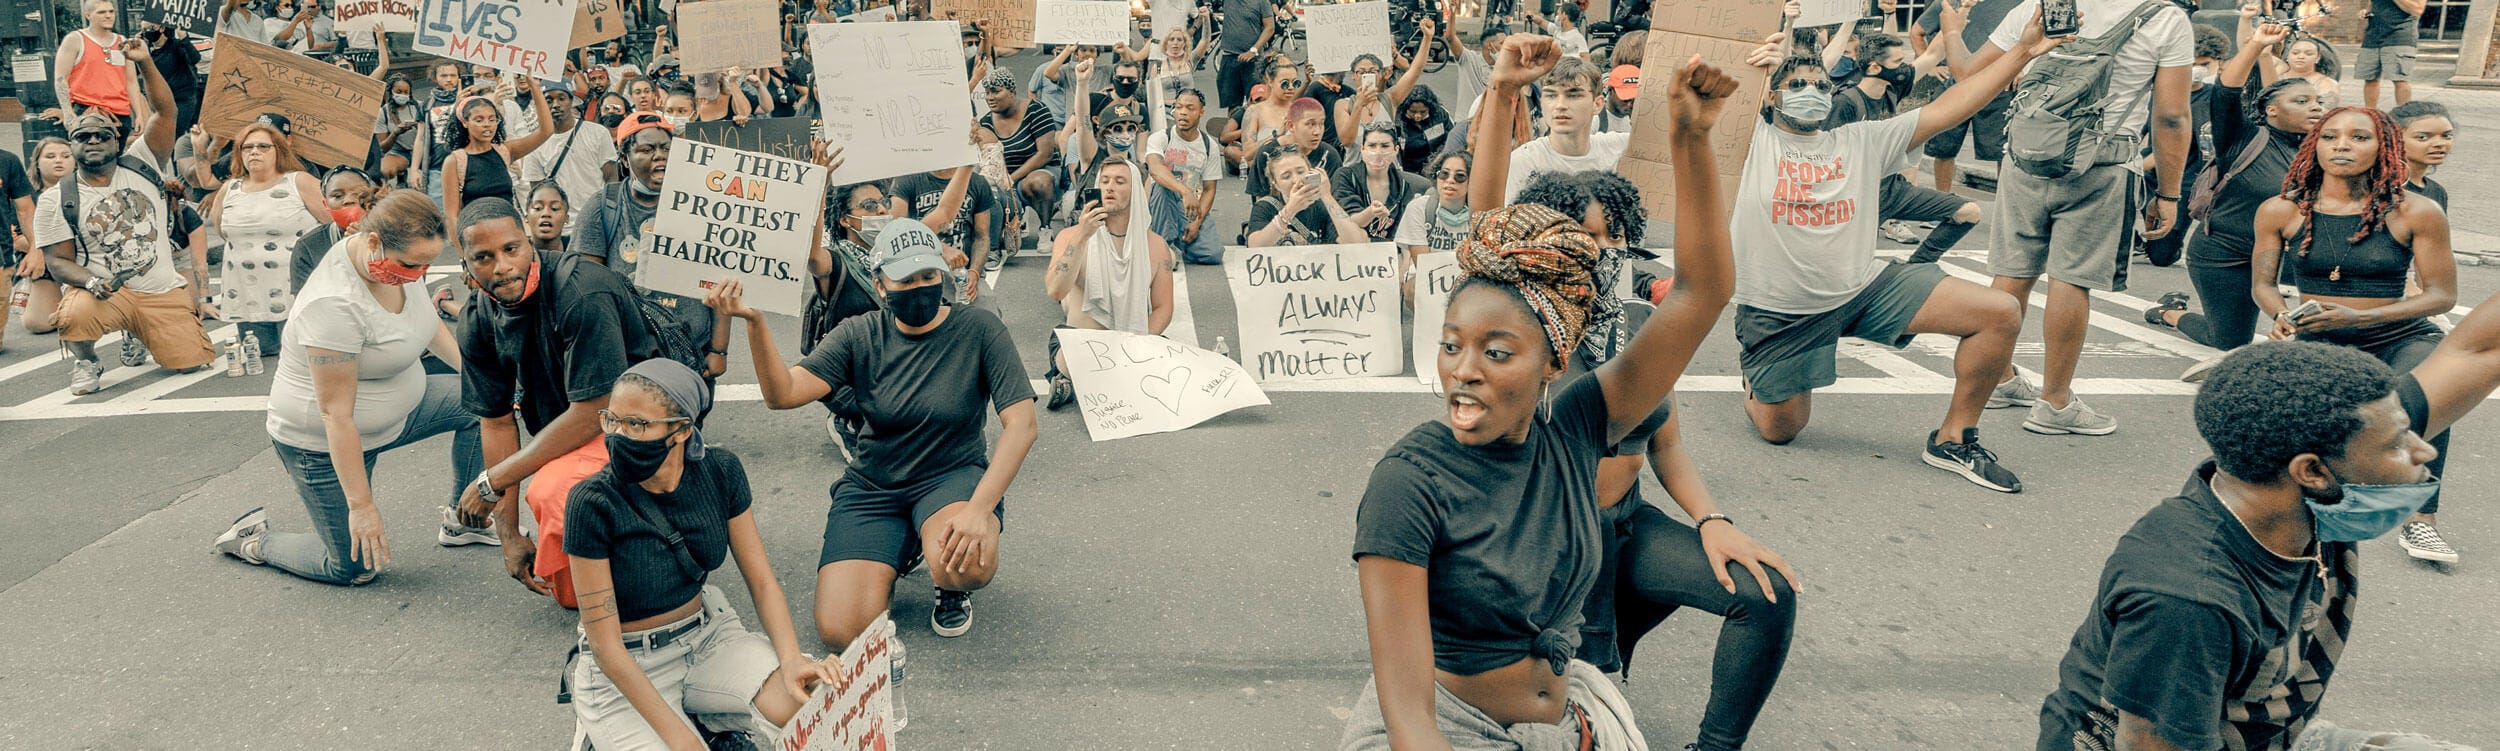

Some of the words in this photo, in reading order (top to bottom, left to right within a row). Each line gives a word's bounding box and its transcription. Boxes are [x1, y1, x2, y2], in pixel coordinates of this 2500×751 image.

[162, 12, 192, 29] ACAB
[337, 1, 379, 21] AGAINST
[419, 0, 522, 47] LIVES
[986, 18, 1032, 30] RUTALITY
[1050, 5, 1125, 17] FIGHTING
[1695, 6, 1738, 28] THE
[992, 27, 1032, 41] PEACE
[450, 34, 547, 74] MATTER
[862, 35, 892, 70] NO
[876, 98, 906, 138] NO
[686, 143, 716, 166] IF
[734, 152, 812, 185] THEY
[705, 170, 767, 202] CAN
[916, 191, 970, 209] JOHY
[1772, 178, 1816, 203] ARE
[670, 190, 800, 232] PROTEST
[1772, 198, 1855, 227] PISSED!
[703, 222, 757, 252] FOR
[890, 230, 936, 255] HEELS
[651, 234, 799, 282] HAIRCUTS...
[1246, 254, 1326, 287] Black
[1335, 253, 1396, 282] Lives
[1279, 290, 1377, 328] ALWAYS
